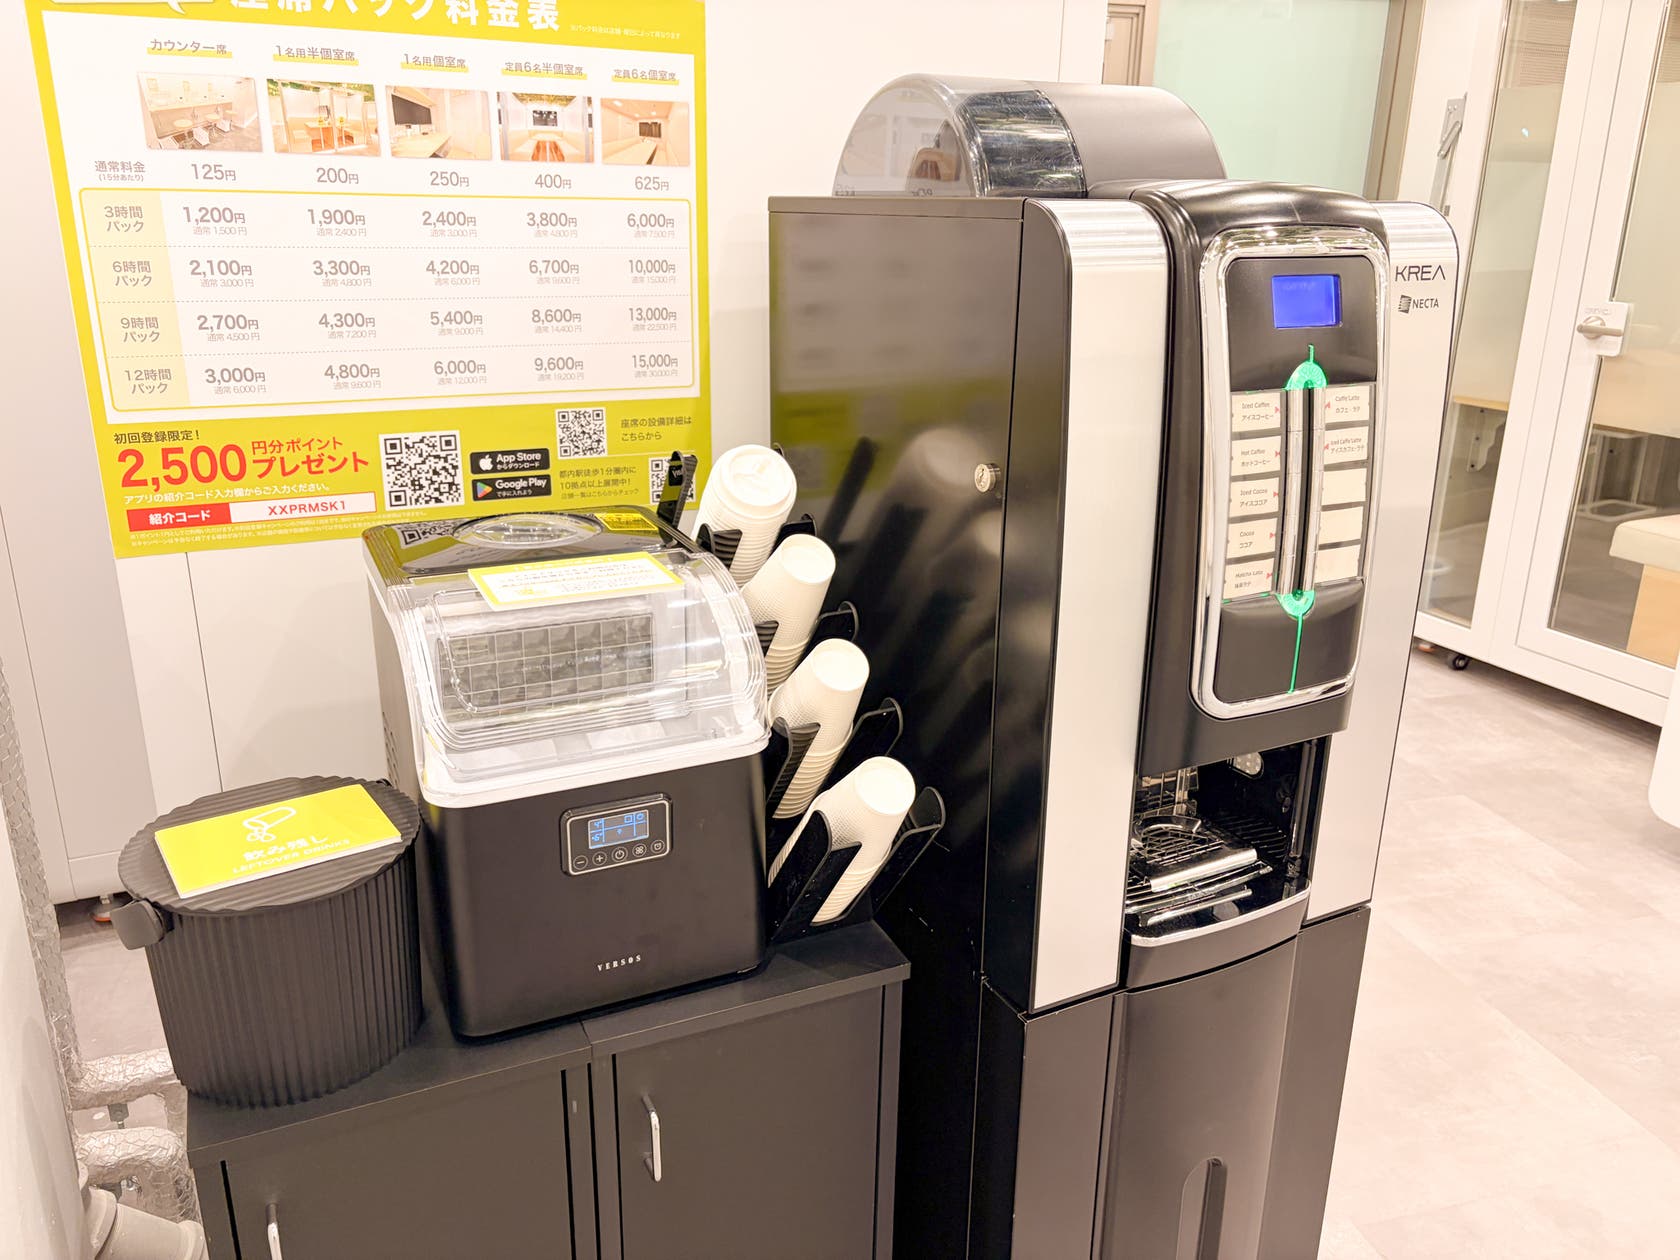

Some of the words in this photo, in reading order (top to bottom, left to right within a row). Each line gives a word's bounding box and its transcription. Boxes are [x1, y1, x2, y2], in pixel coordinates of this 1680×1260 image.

[150, 39, 227, 55] カウンター席
[276, 45, 356, 62] 1名用半個室席
[404, 54, 466, 69] 1名用個室席
[504, 61, 584, 77] 定員6名半個室席
[614, 68, 677, 81] 定員6名個室席
[95, 160, 146, 173] 通常料金
[192, 163, 236, 181] 125円
[317, 167, 359, 185] 200円
[430, 171, 470, 188] 250円
[535, 174, 572, 190] 400円
[635, 176, 669, 191] 625円
[105, 206, 143, 219] 3時間
[183, 207, 245, 226] 1,200円
[307, 209, 366, 227] 1,900円
[422, 211, 476, 229] 2,400円
[107, 221, 144, 233] パック
[527, 213, 577, 229] 3,800円
[627, 213, 674, 230] 6,000円
[113, 261, 151, 274] 6時間
[190, 260, 252, 278] 2,100円
[313, 260, 370, 278] 3,300円
[426, 259, 479, 277] 4,200円
[529, 259, 579, 276] 6,700円
[629, 259, 676, 275] 10,000円
[116, 275, 152, 287] パック
[1412, 298, 1439, 309] NECTA
[121, 317, 159, 330] 9時間
[319, 313, 375, 331] 4,300円
[430, 310, 483, 327] 5,400円
[532, 309, 581, 325] 8,600円
[629, 308, 677, 323] 13,000円
[197, 315, 259, 333] 2,700円
[124, 331, 160, 343] パック
[434, 360, 486, 377] 6,000円
[535, 358, 584, 373] 9,600円
[632, 355, 678, 369] 15,000円
[124, 369, 172, 381] 12時間
[204, 367, 265, 385] 3,000円
[324, 364, 380, 382] 4,800円
[132, 382, 168, 395] パック
[621, 416, 692, 428] 座席の設備詳細は
[114, 430, 200, 444] 初回登録限定!
[621, 432, 662, 442] こちらから
[118, 444, 247, 493] 2,500
[252, 436, 343, 456] 円分ポイント
[252, 451, 369, 479] プレゼント
[496, 454, 516, 463] App
[517, 452, 541, 461] Store
[496, 462, 540, 470] からダウンロード
[495, 479, 528, 490] Google
[529, 477, 547, 488] Play
[496, 489, 533, 497] で手に入れよう
[148, 510, 211, 525] 紹介コード
[269, 501, 347, 516] XXPRMSK1
[243, 836, 329, 862] 飲み残し
[233, 852, 300, 874] LEFTOVER
[597, 955, 642, 972] VERSOS
